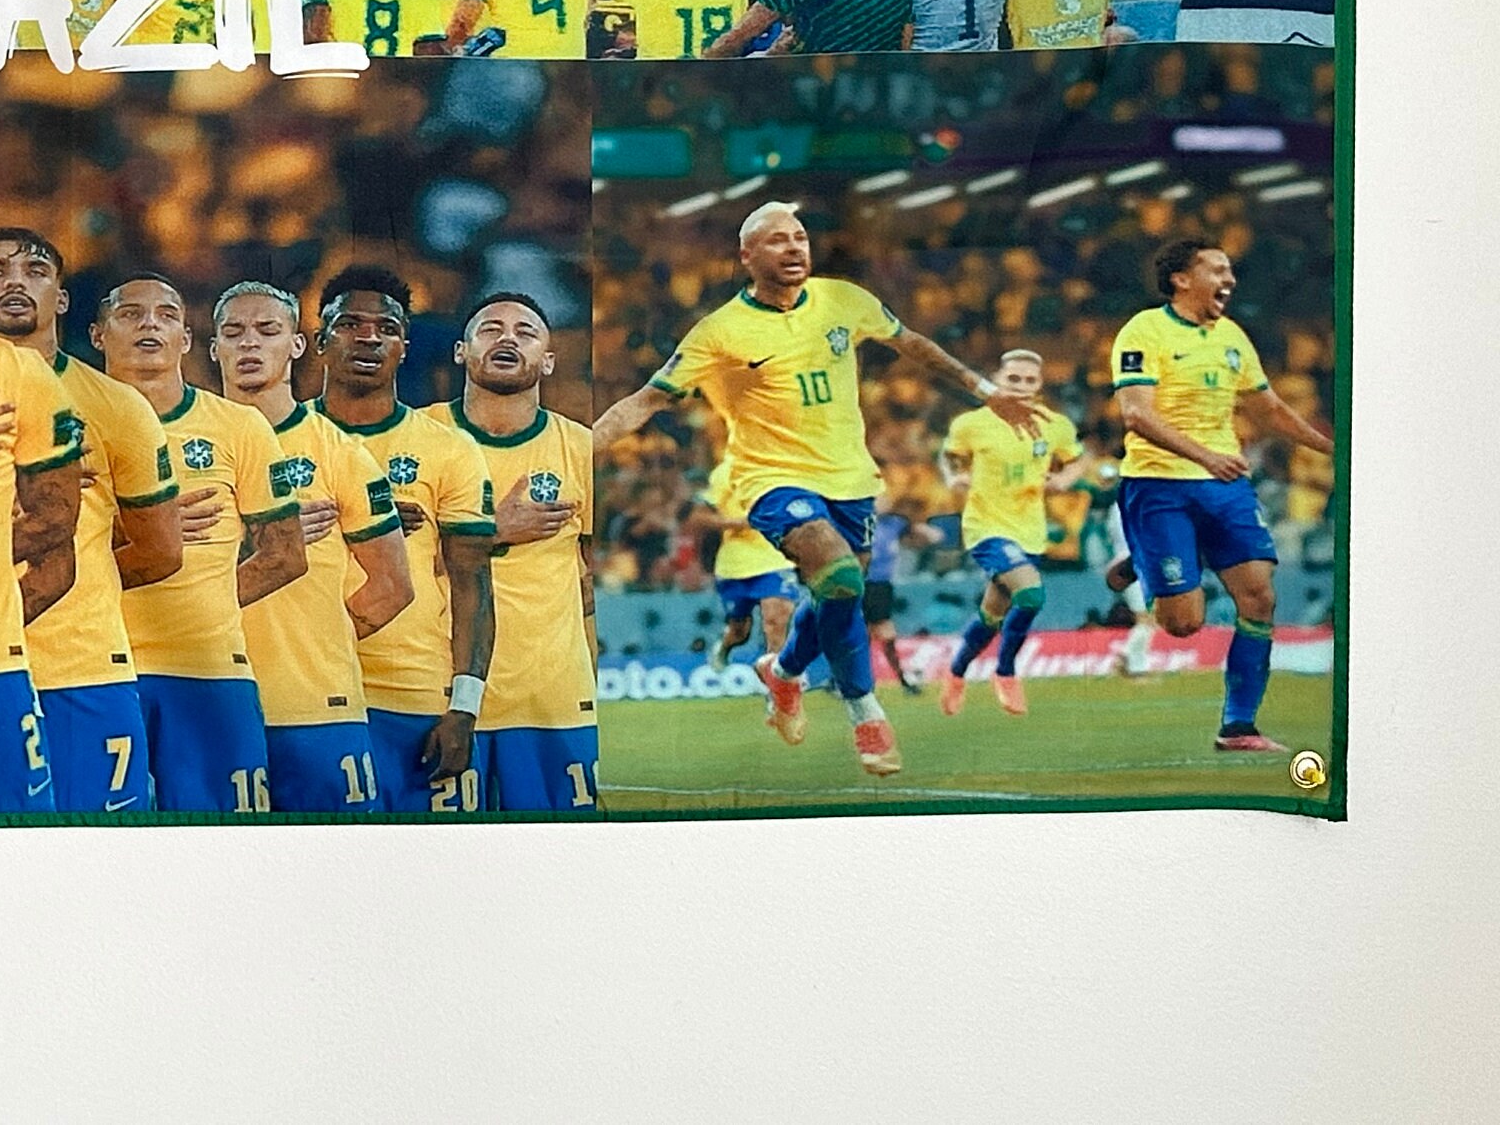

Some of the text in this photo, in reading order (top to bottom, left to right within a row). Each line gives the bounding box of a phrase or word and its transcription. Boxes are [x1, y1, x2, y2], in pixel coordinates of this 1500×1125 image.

[796, 370, 833, 407] 10
[20, 713, 46, 771] 2
[106, 736, 133, 792] 7
[230, 767, 271, 813] 16
[429, 768, 479, 813] 20
